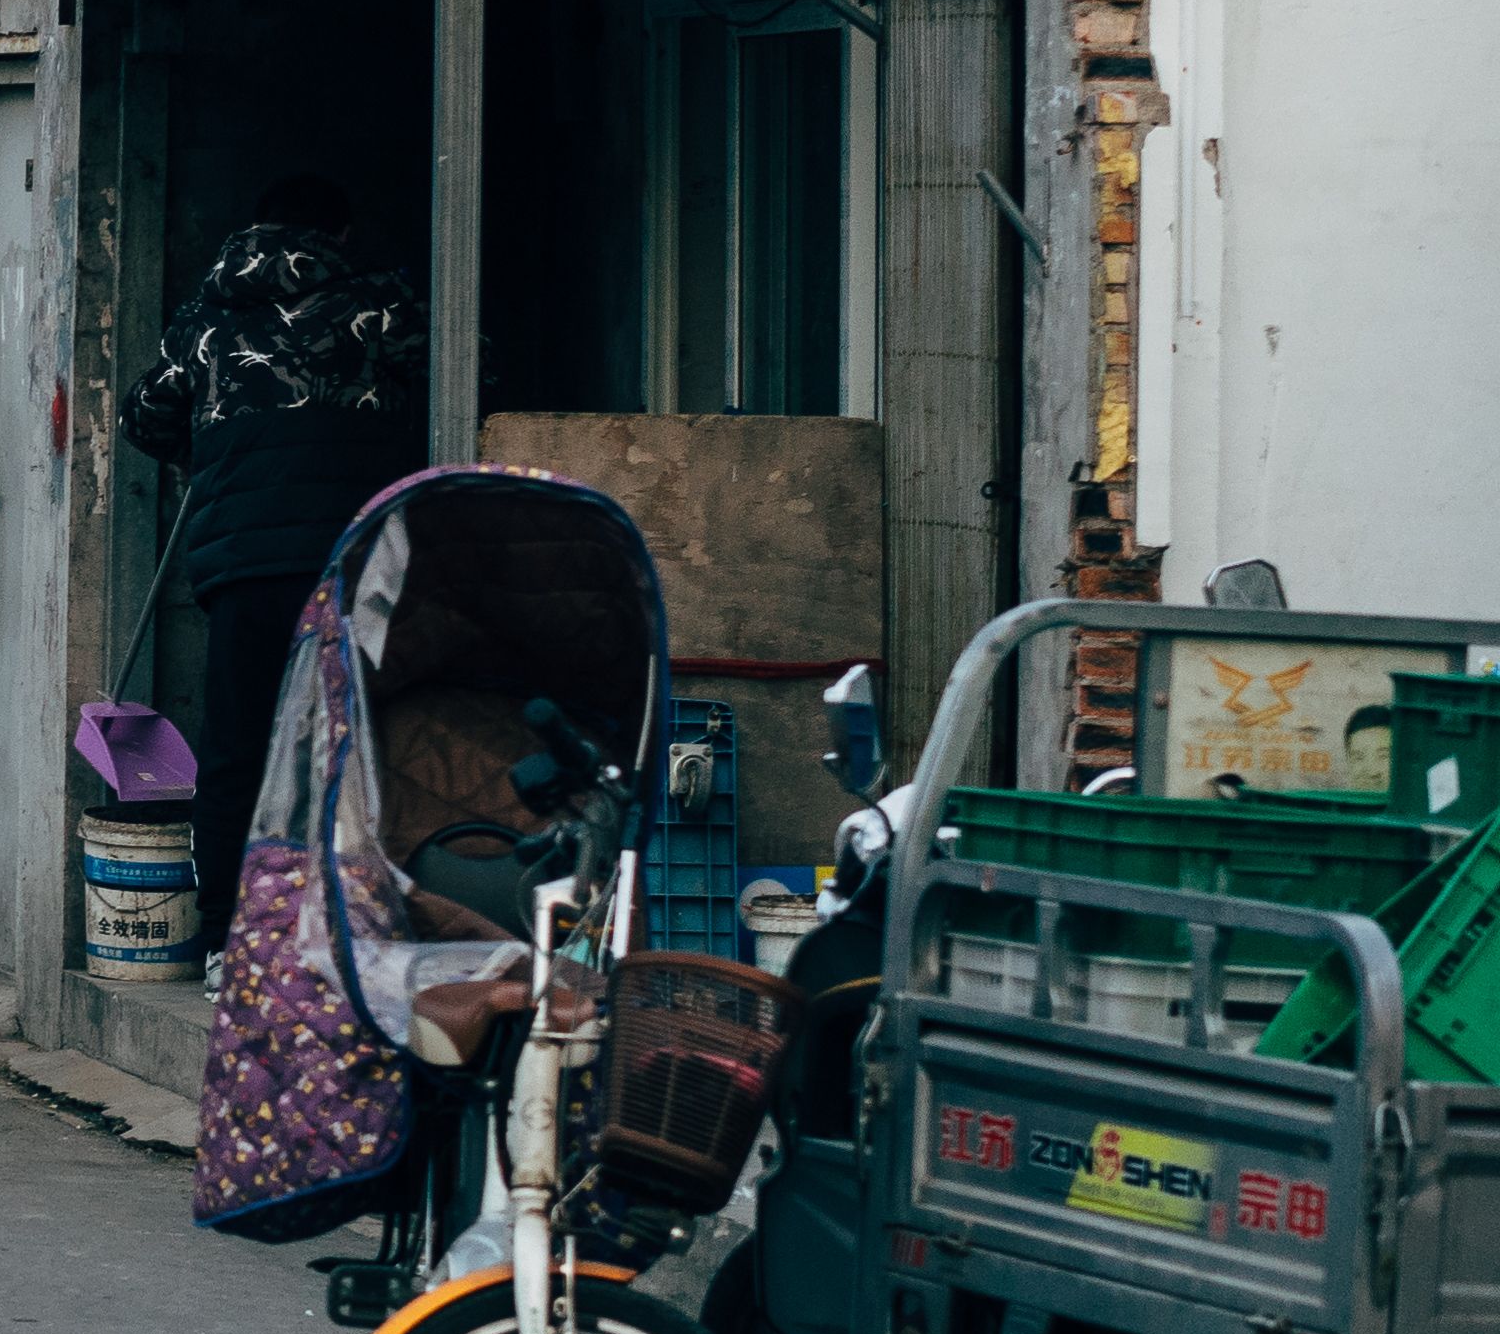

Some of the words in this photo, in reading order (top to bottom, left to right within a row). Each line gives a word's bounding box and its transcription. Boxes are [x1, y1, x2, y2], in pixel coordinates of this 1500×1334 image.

[98, 916, 169, 940] 全效墙固
[940, 1107, 1017, 1170] 江苏
[1238, 1171, 1328, 1240] 宗申
